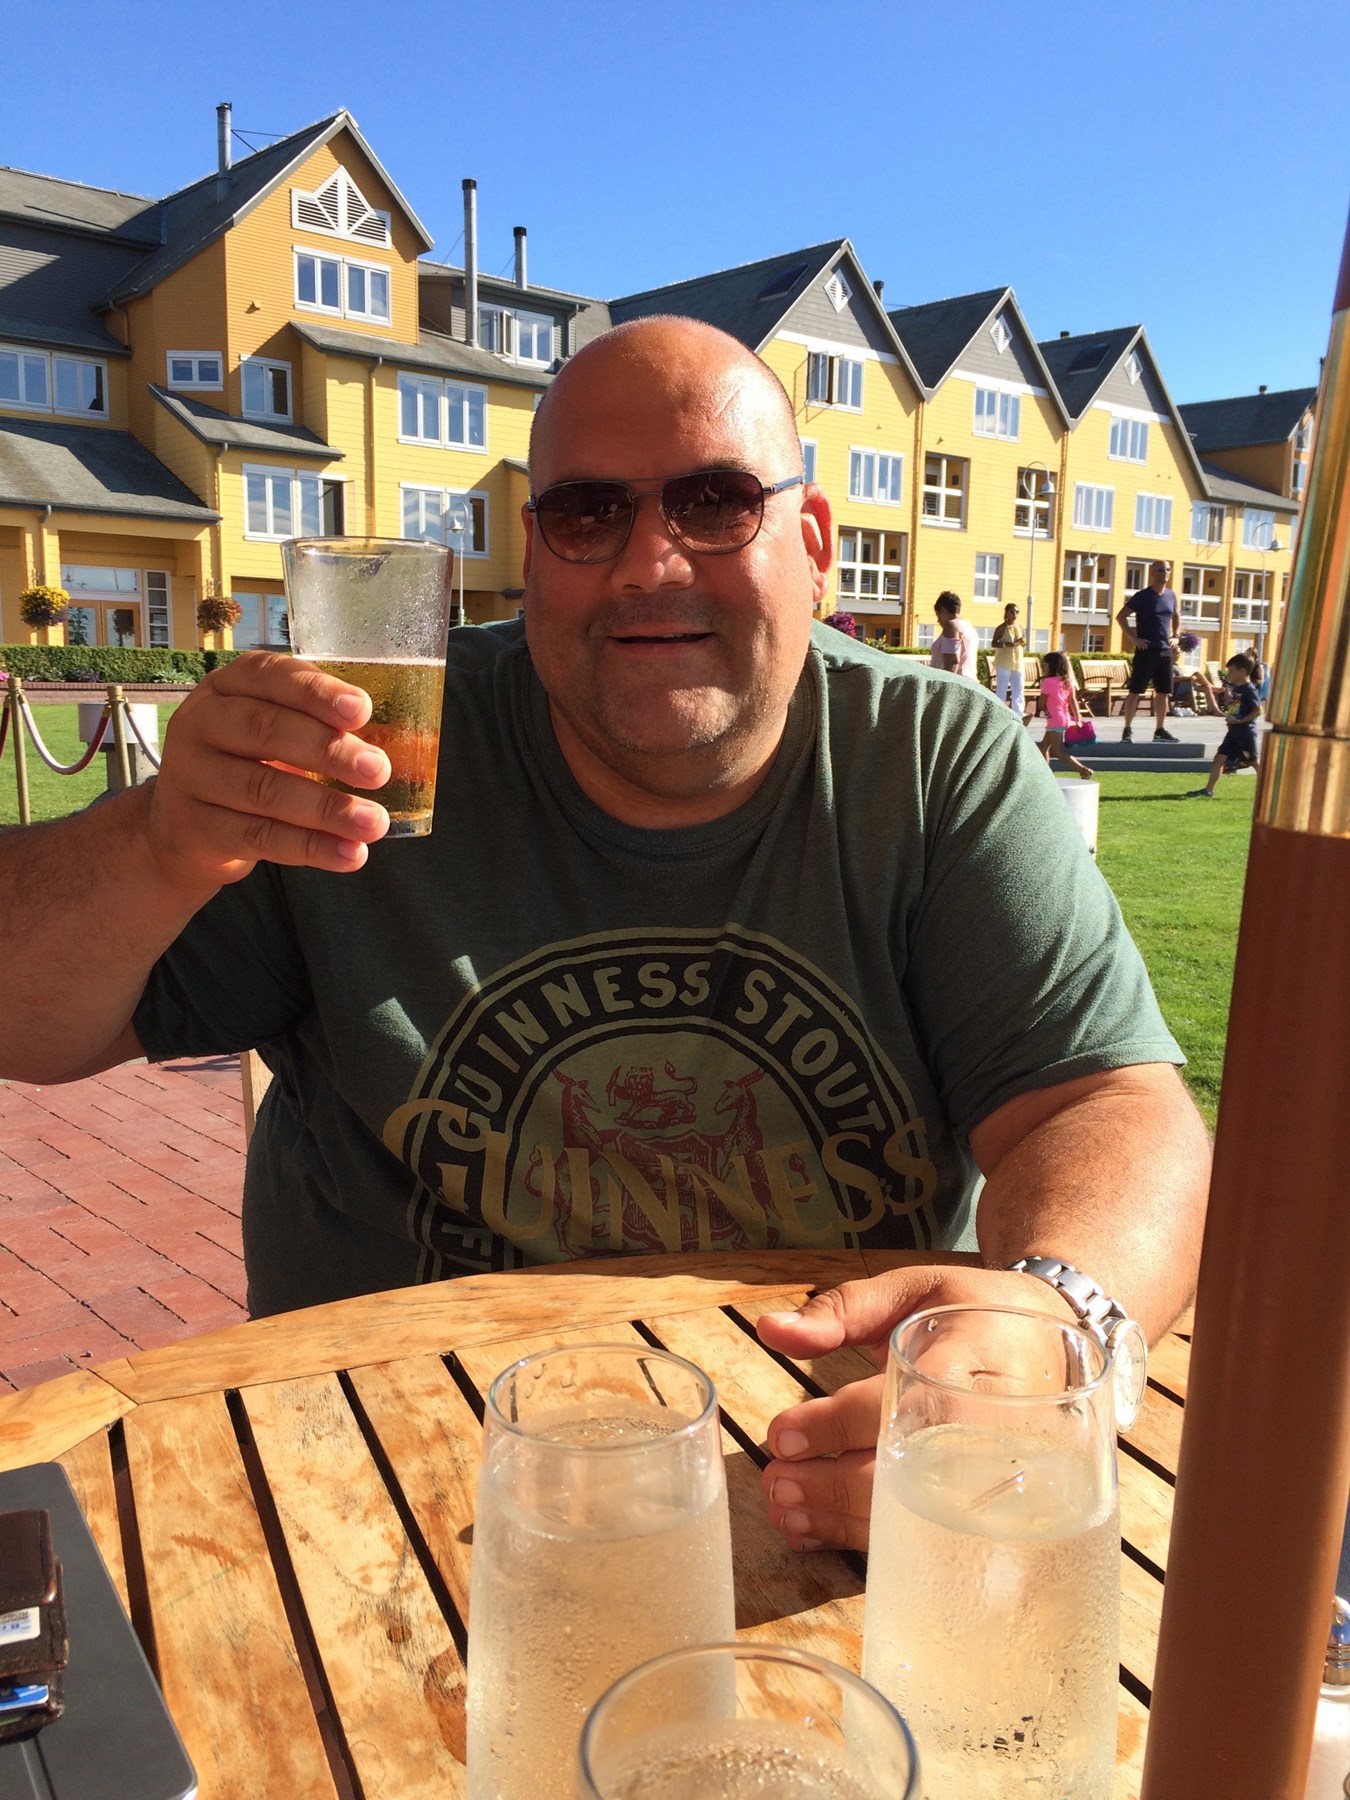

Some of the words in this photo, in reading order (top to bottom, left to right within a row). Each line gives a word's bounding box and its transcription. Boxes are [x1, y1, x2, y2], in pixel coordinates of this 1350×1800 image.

[437, 961, 711, 1152] GUINNESS
[734, 968, 886, 1132] STOUT
[382, 1098, 938, 1252] GUINNESS
